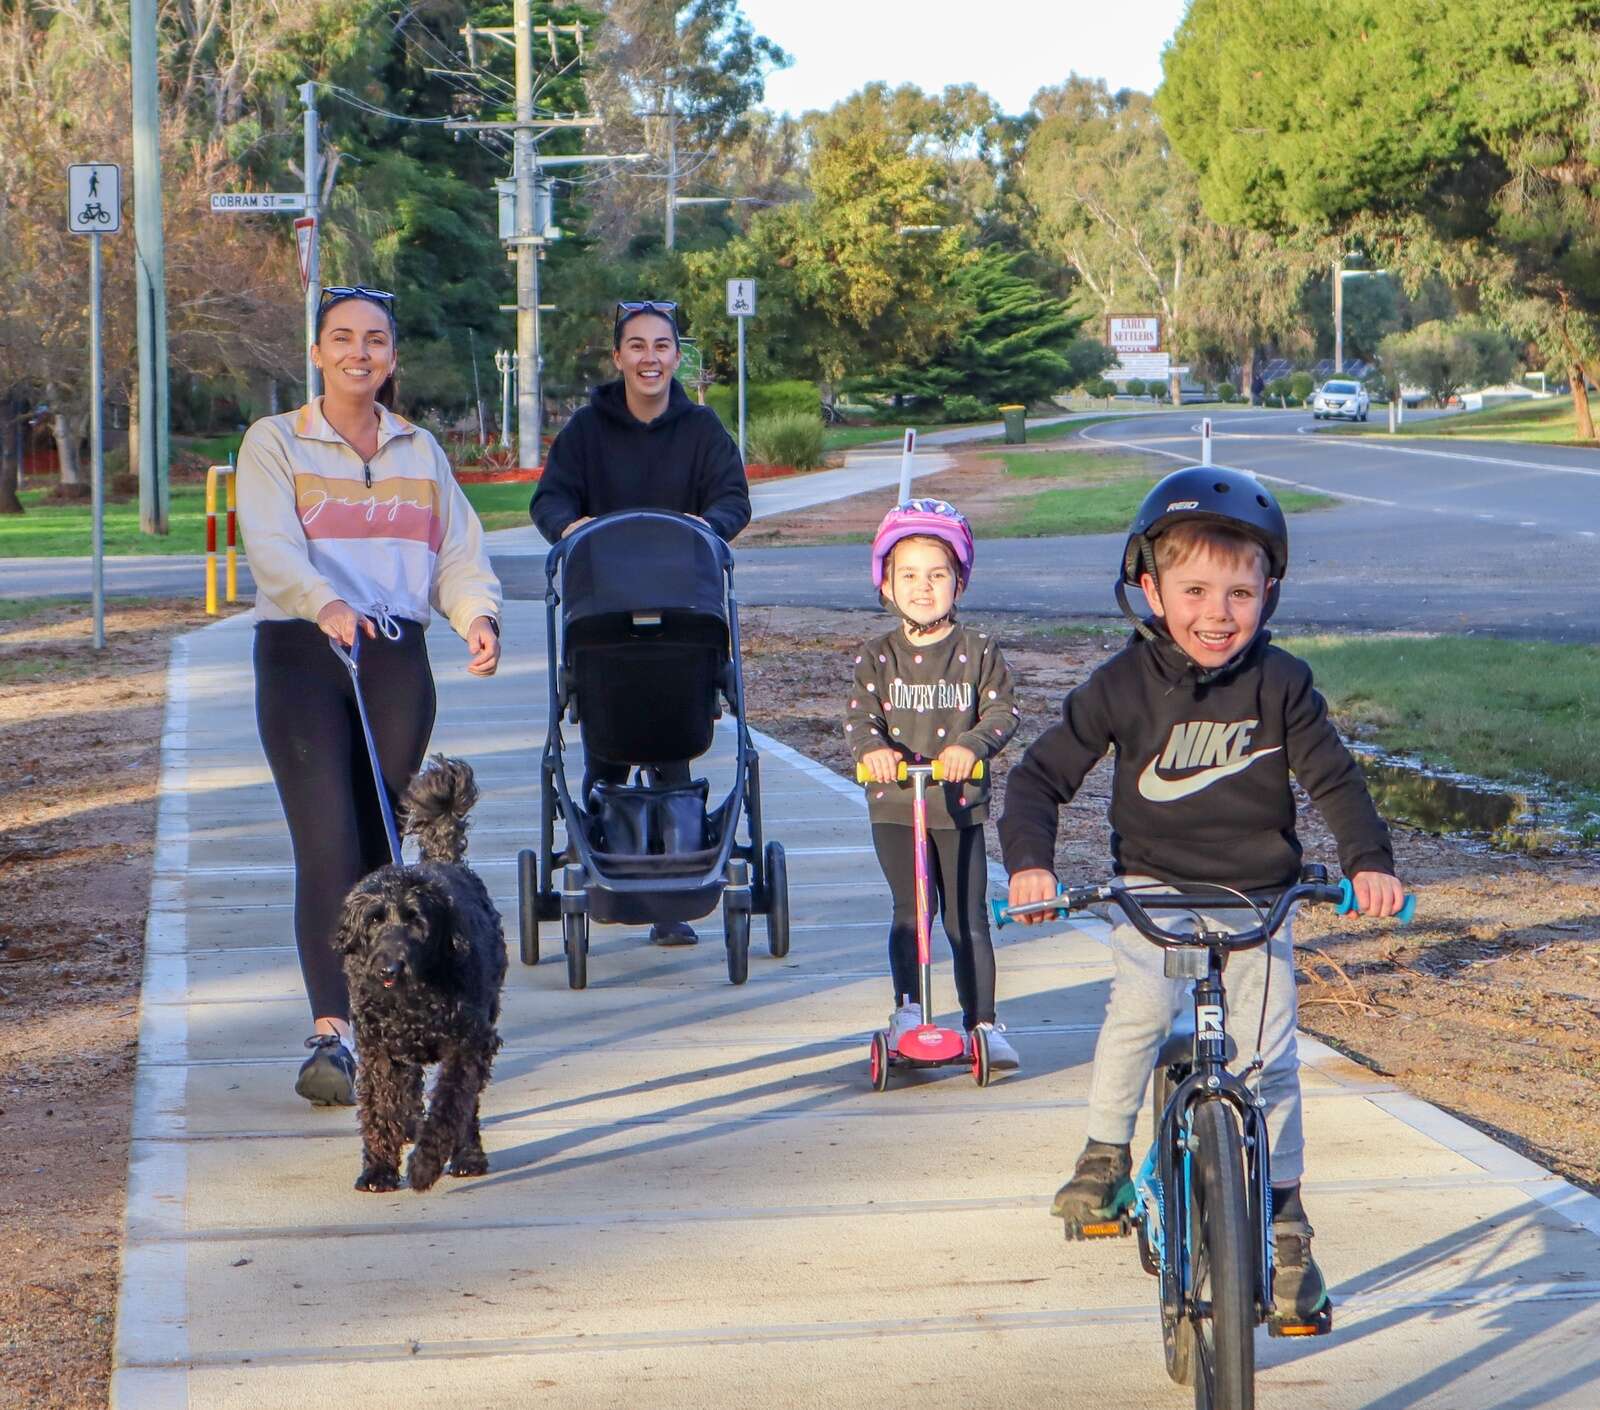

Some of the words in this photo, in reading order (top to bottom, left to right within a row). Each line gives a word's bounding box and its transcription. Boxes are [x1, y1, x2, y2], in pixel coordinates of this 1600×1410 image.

[212, 195, 258, 208] COBRAM
[263, 195, 276, 208] ST
[938, 682, 972, 709] ROAD
[1159, 719, 1259, 770] NIKE
[1197, 1005, 1224, 1031] R
[1198, 1031, 1224, 1041] REID
